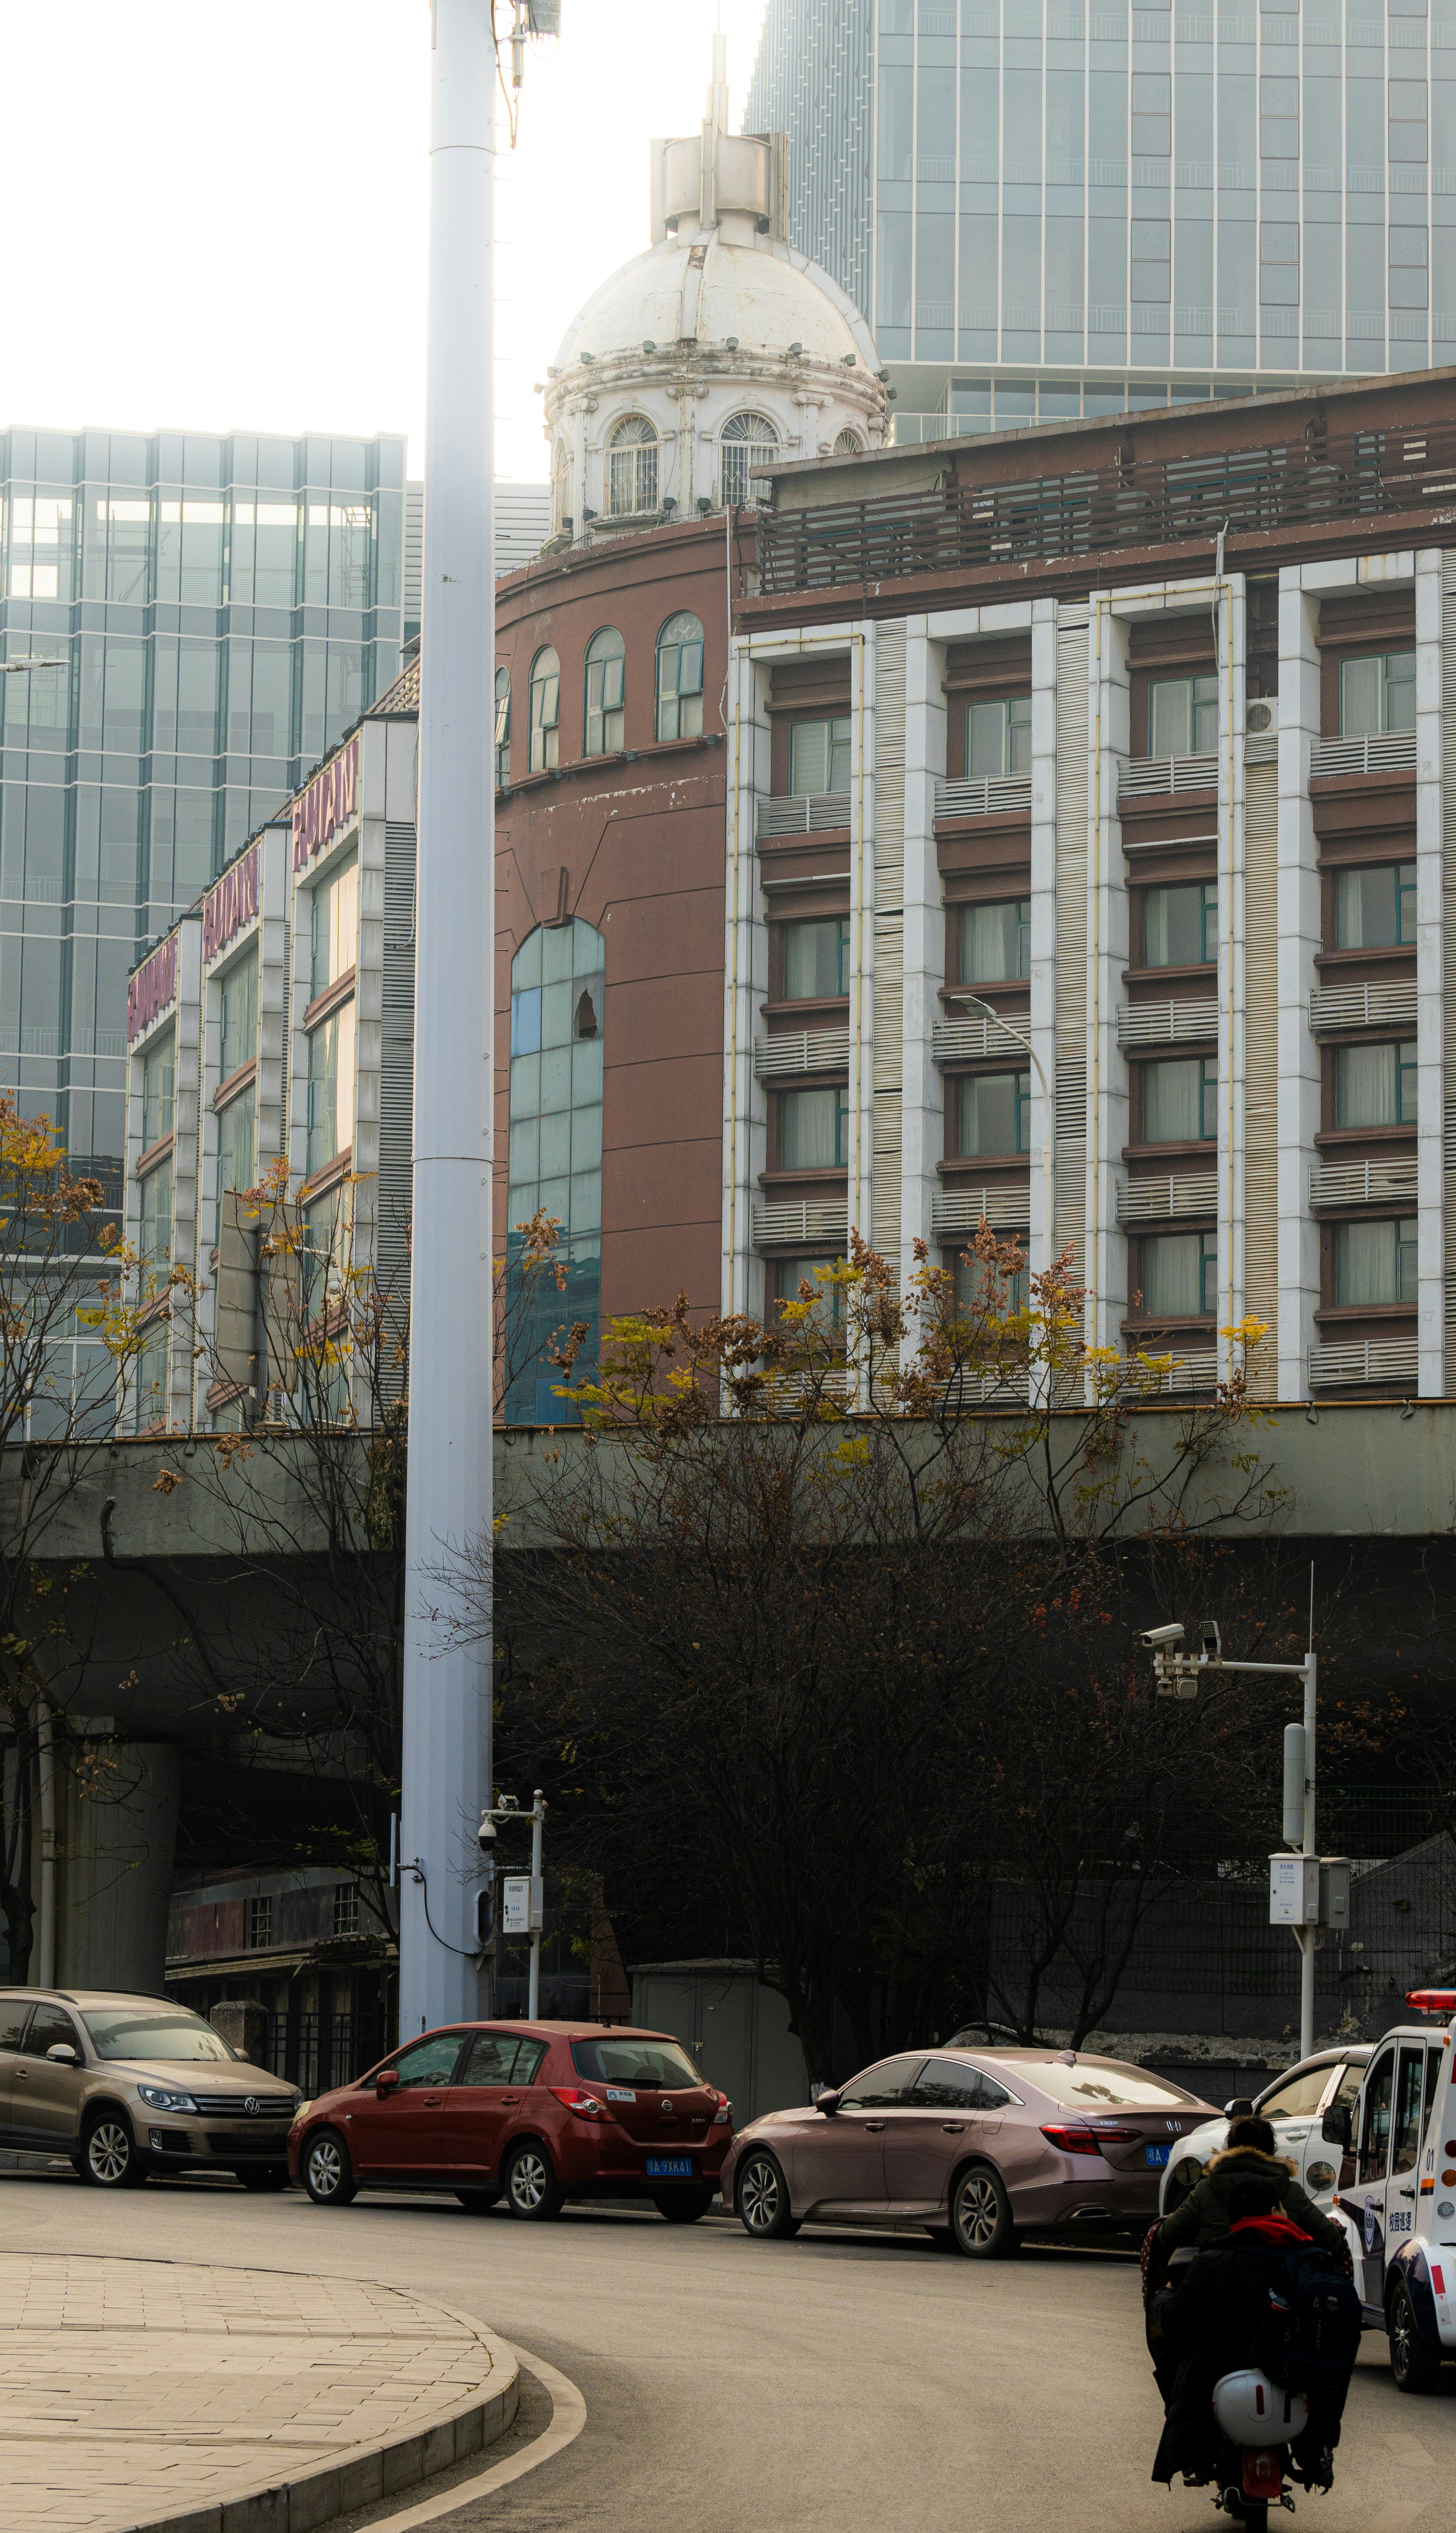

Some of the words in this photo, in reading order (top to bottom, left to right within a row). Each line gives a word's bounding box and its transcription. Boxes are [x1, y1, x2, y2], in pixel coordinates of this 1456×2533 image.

[1426, 2148, 1434, 2172] 01
[1389, 2211, 1411, 2232] 校园巡逻
